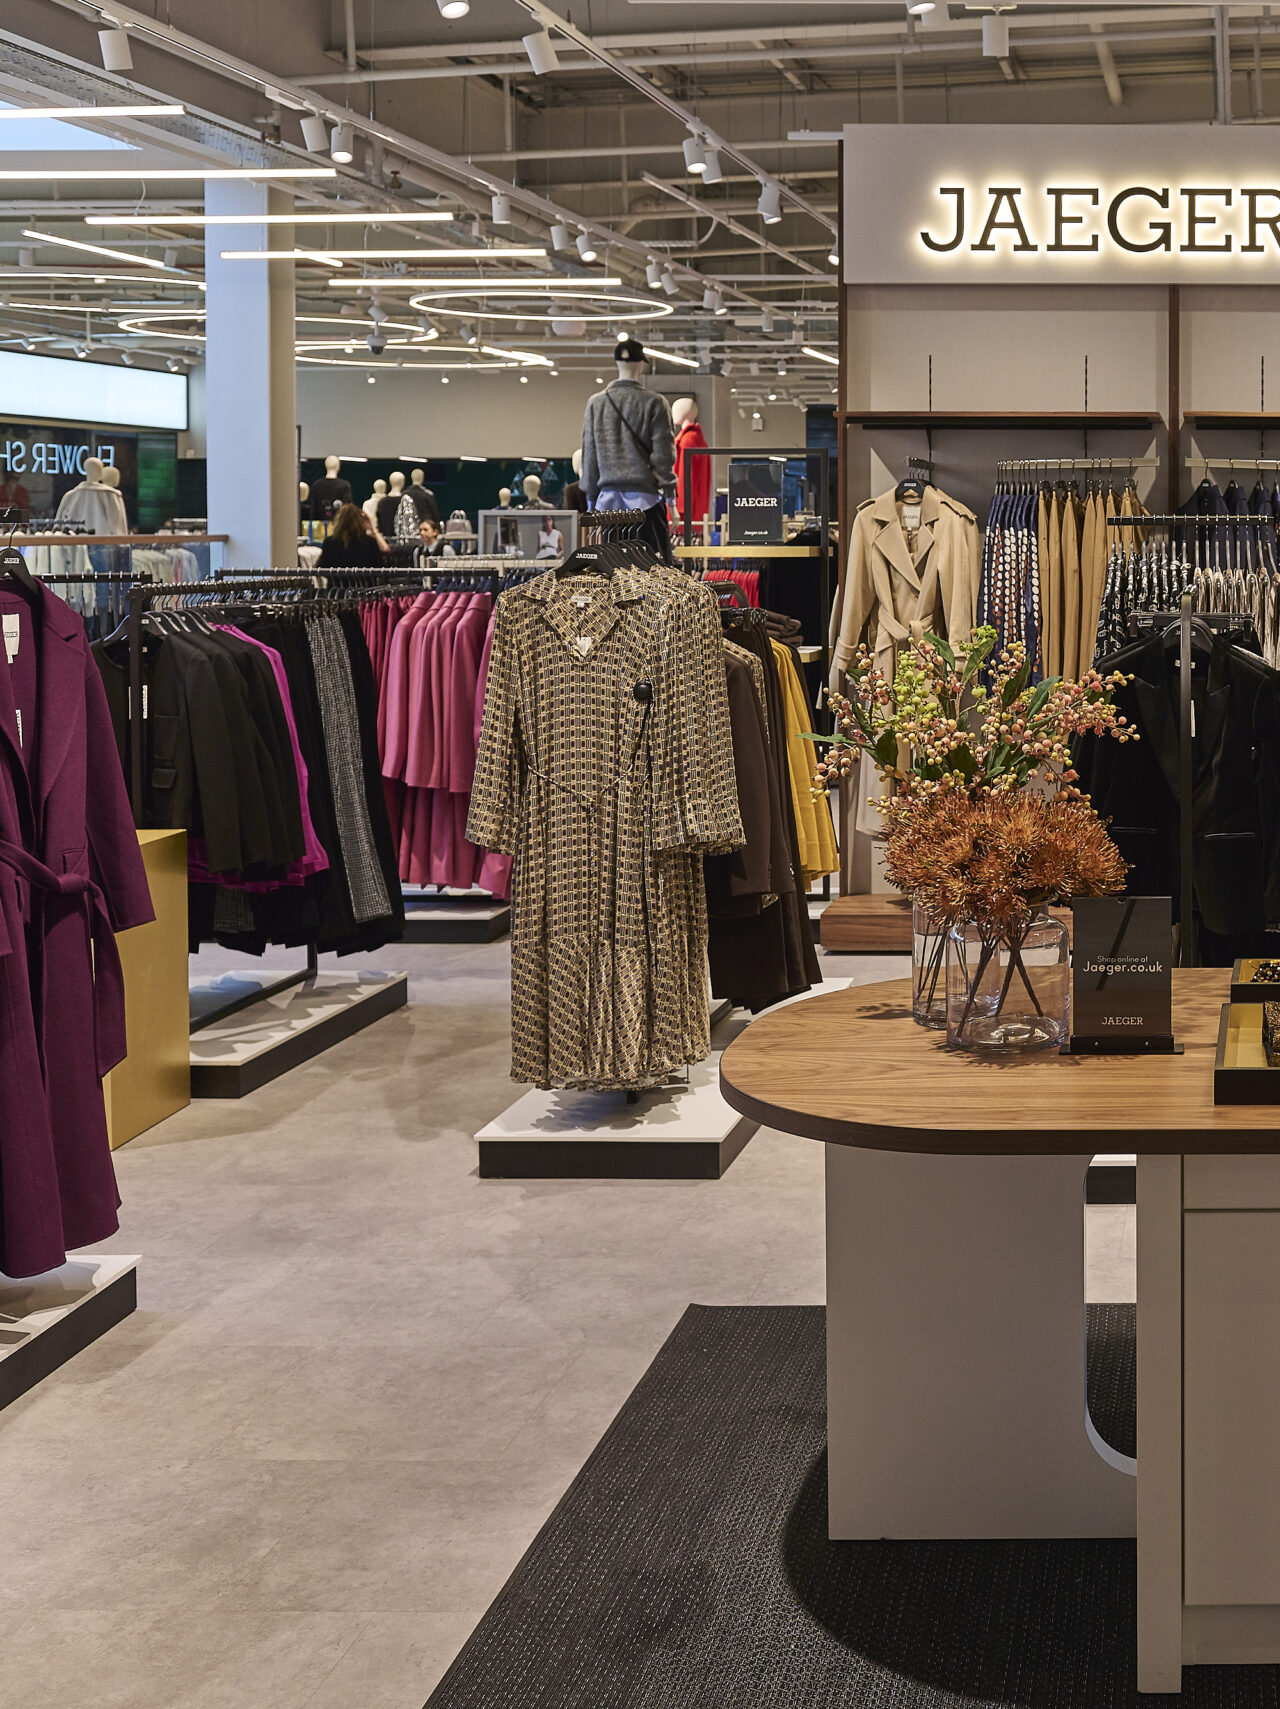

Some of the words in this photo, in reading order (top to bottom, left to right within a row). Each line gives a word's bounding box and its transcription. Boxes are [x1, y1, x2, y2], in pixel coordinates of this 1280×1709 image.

[734, 497, 778, 507] JAEGER
[1097, 955, 1116, 964] Shop
[1117, 955, 1139, 963] online
[1140, 955, 1148, 963] at
[1083, 960, 1163, 976] Jaeger.co.uk
[1101, 1016, 1144, 1026] JAEGER
